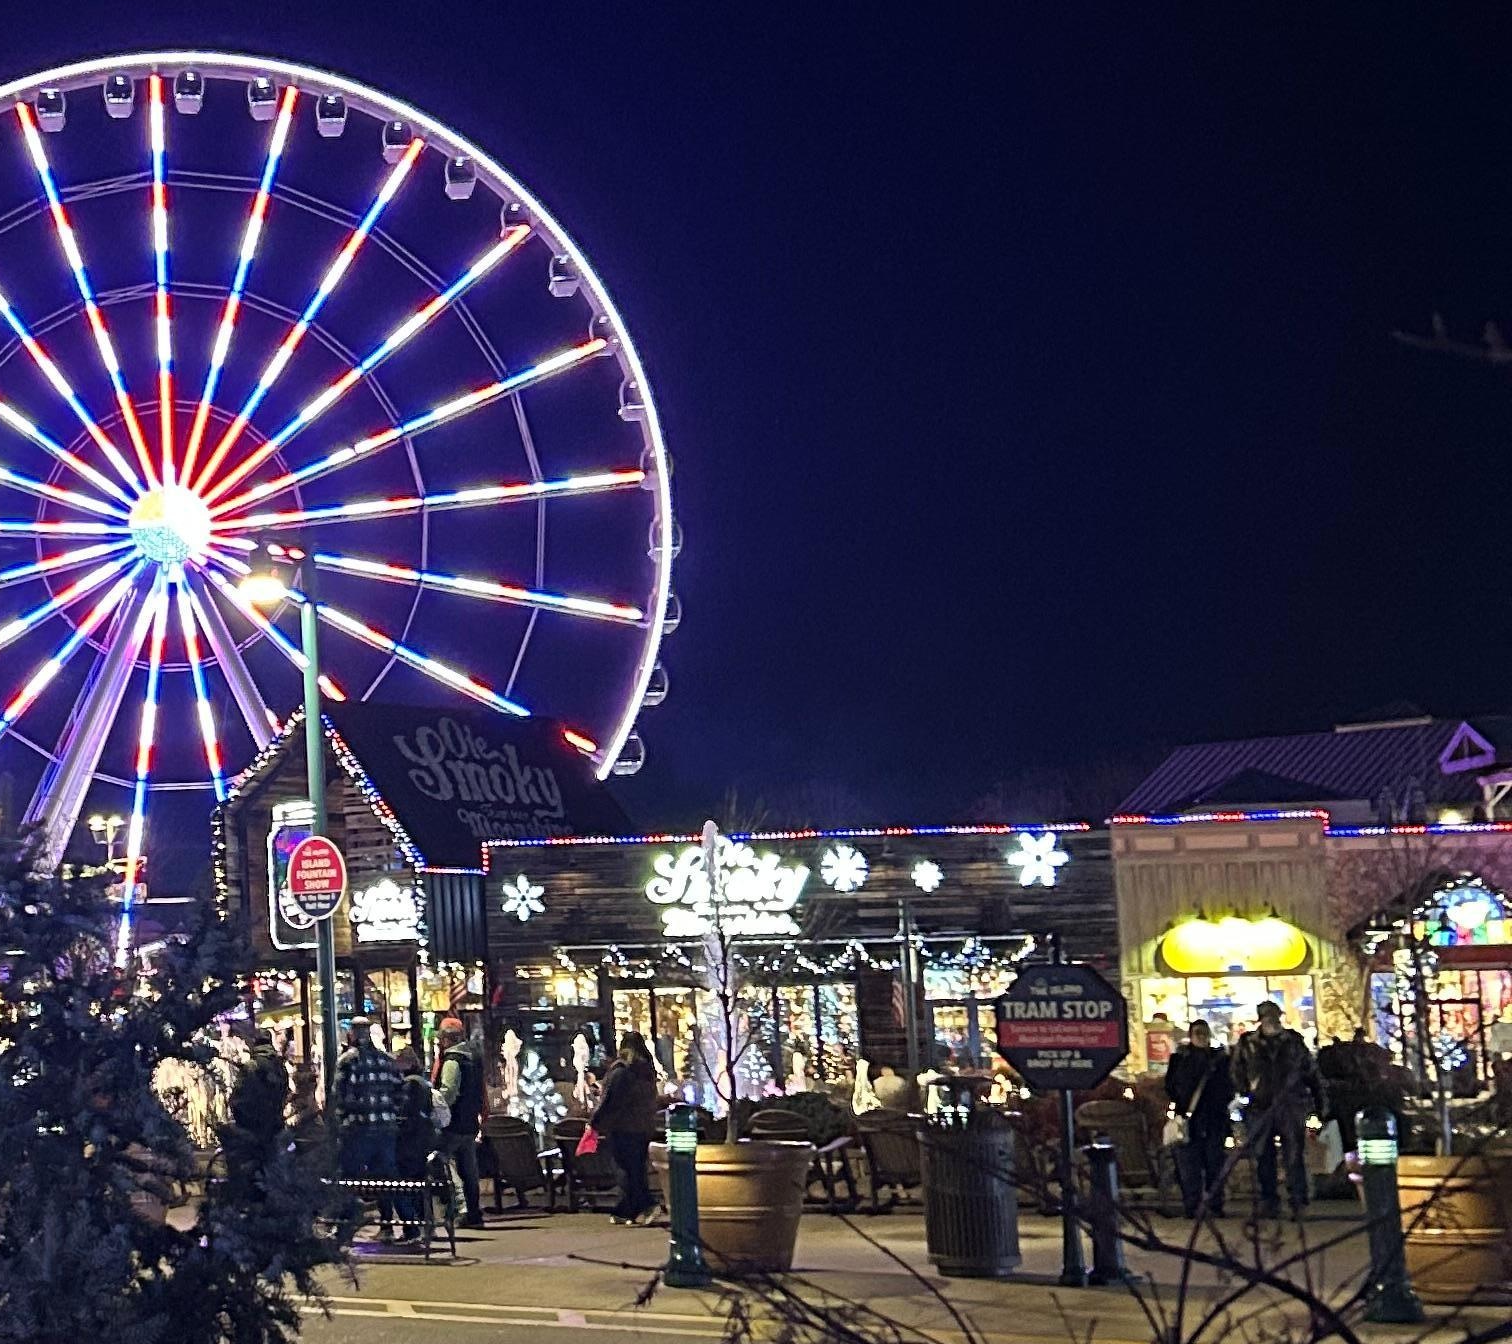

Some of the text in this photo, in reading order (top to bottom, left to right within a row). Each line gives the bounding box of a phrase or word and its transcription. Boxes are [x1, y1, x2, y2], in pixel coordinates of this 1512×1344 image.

[439, 717, 506, 762] Ole
[393, 726, 565, 818] Smoky
[300, 859, 332, 870] ISLAND
[295, 868, 338, 881] FOUNTAIN
[303, 879, 330, 891] SHOW
[1002, 1000, 1113, 1019] TRAM STOP
